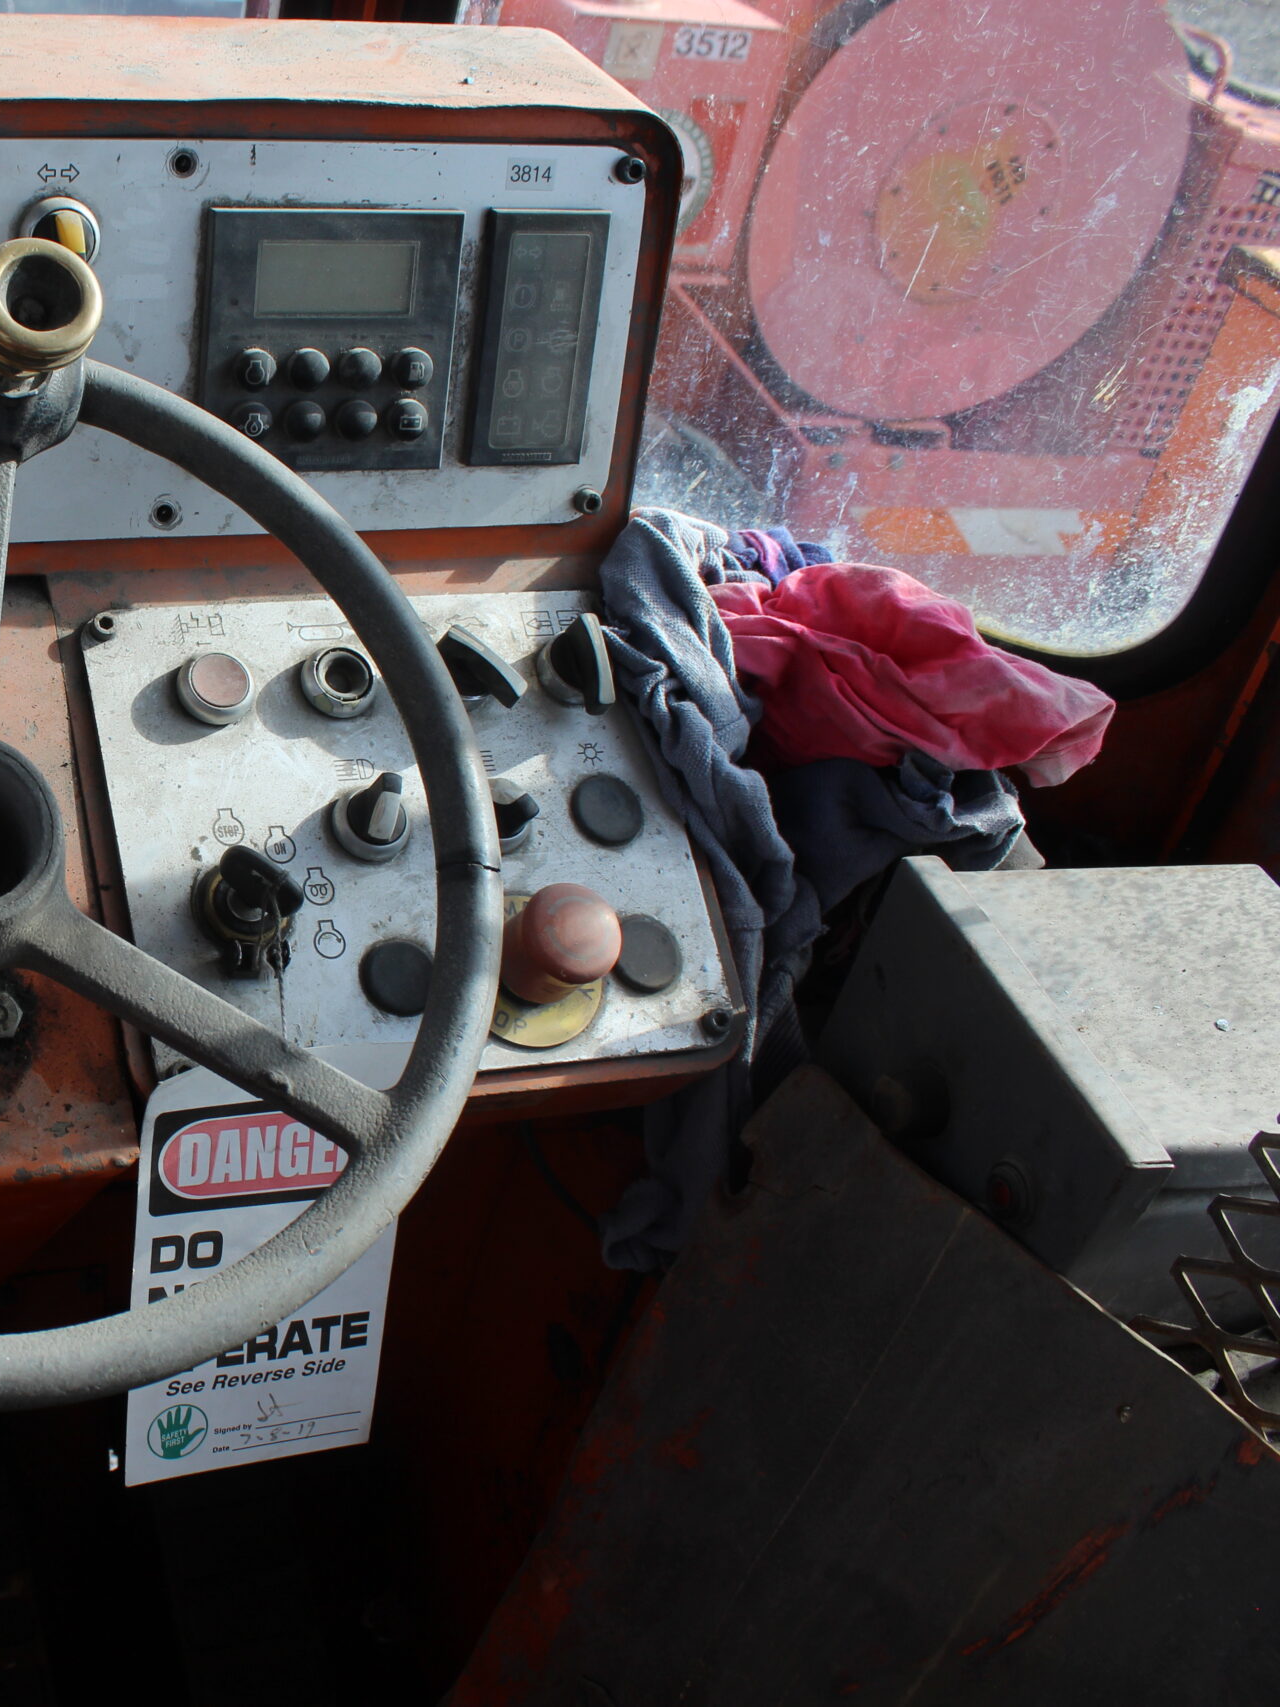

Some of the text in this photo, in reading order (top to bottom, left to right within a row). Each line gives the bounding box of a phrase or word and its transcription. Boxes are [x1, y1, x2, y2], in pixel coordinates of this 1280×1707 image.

[675, 30, 749, 59] 3512
[510, 164, 552, 185] 3814
[218, 825, 239, 838] STOP
[274, 843, 287, 855] ON
[494, 1010, 527, 1034] OP
[150, 1230, 224, 1275] DO
[166, 1357, 347, 1397] See Reverse Side
[214, 1422, 253, 1435] Signed by
[161, 1429, 189, 1443] SAFETY
[165, 1436, 186, 1449] FIRST
[212, 1444, 231, 1454] Date
